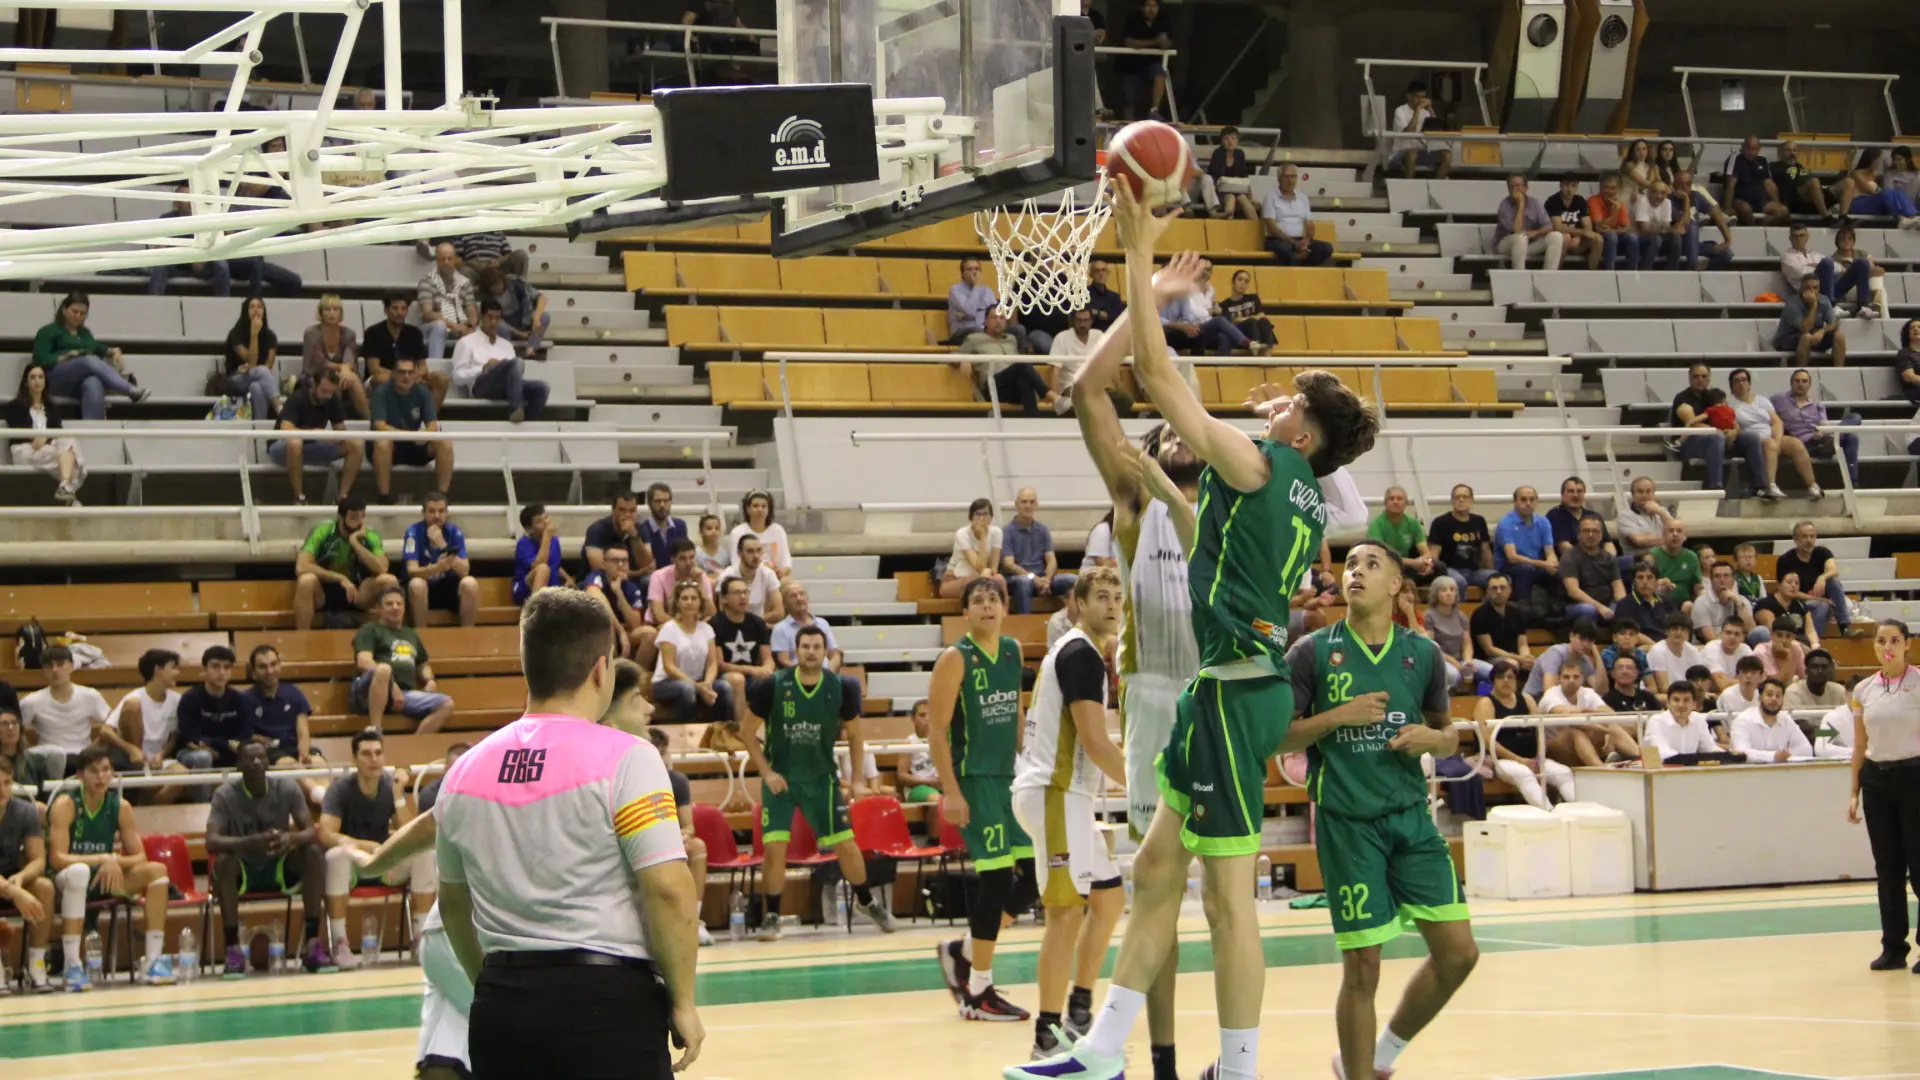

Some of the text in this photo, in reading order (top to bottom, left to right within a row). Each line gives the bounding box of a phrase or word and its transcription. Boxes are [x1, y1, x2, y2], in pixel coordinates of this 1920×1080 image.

[775, 140, 826, 166] e.m.d
[1327, 672, 1354, 703] 32
[782, 700, 796, 718] 16
[983, 823, 1005, 853] 27
[1339, 882, 1373, 922] 32
